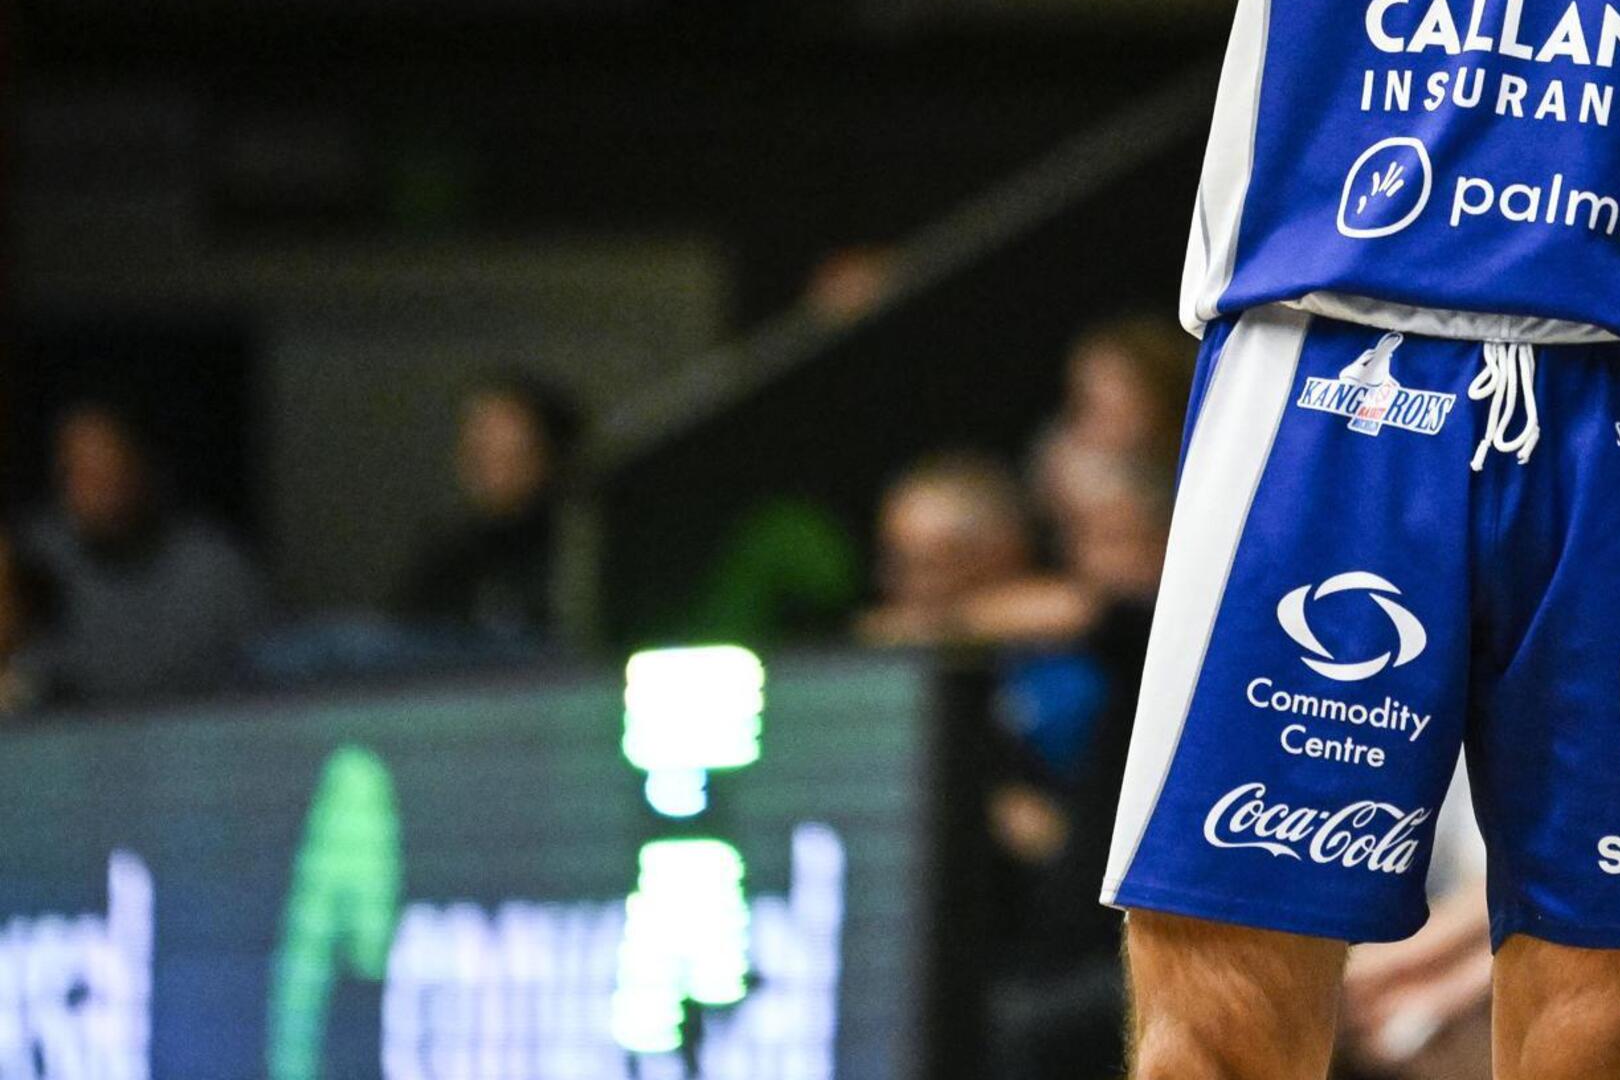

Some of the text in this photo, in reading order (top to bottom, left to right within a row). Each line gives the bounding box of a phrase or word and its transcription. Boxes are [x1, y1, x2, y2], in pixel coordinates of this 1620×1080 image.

[1246, 677, 1432, 742] Commodity
[1280, 724, 1386, 768] Centre
[1203, 782, 1432, 875] Coca-Cola
